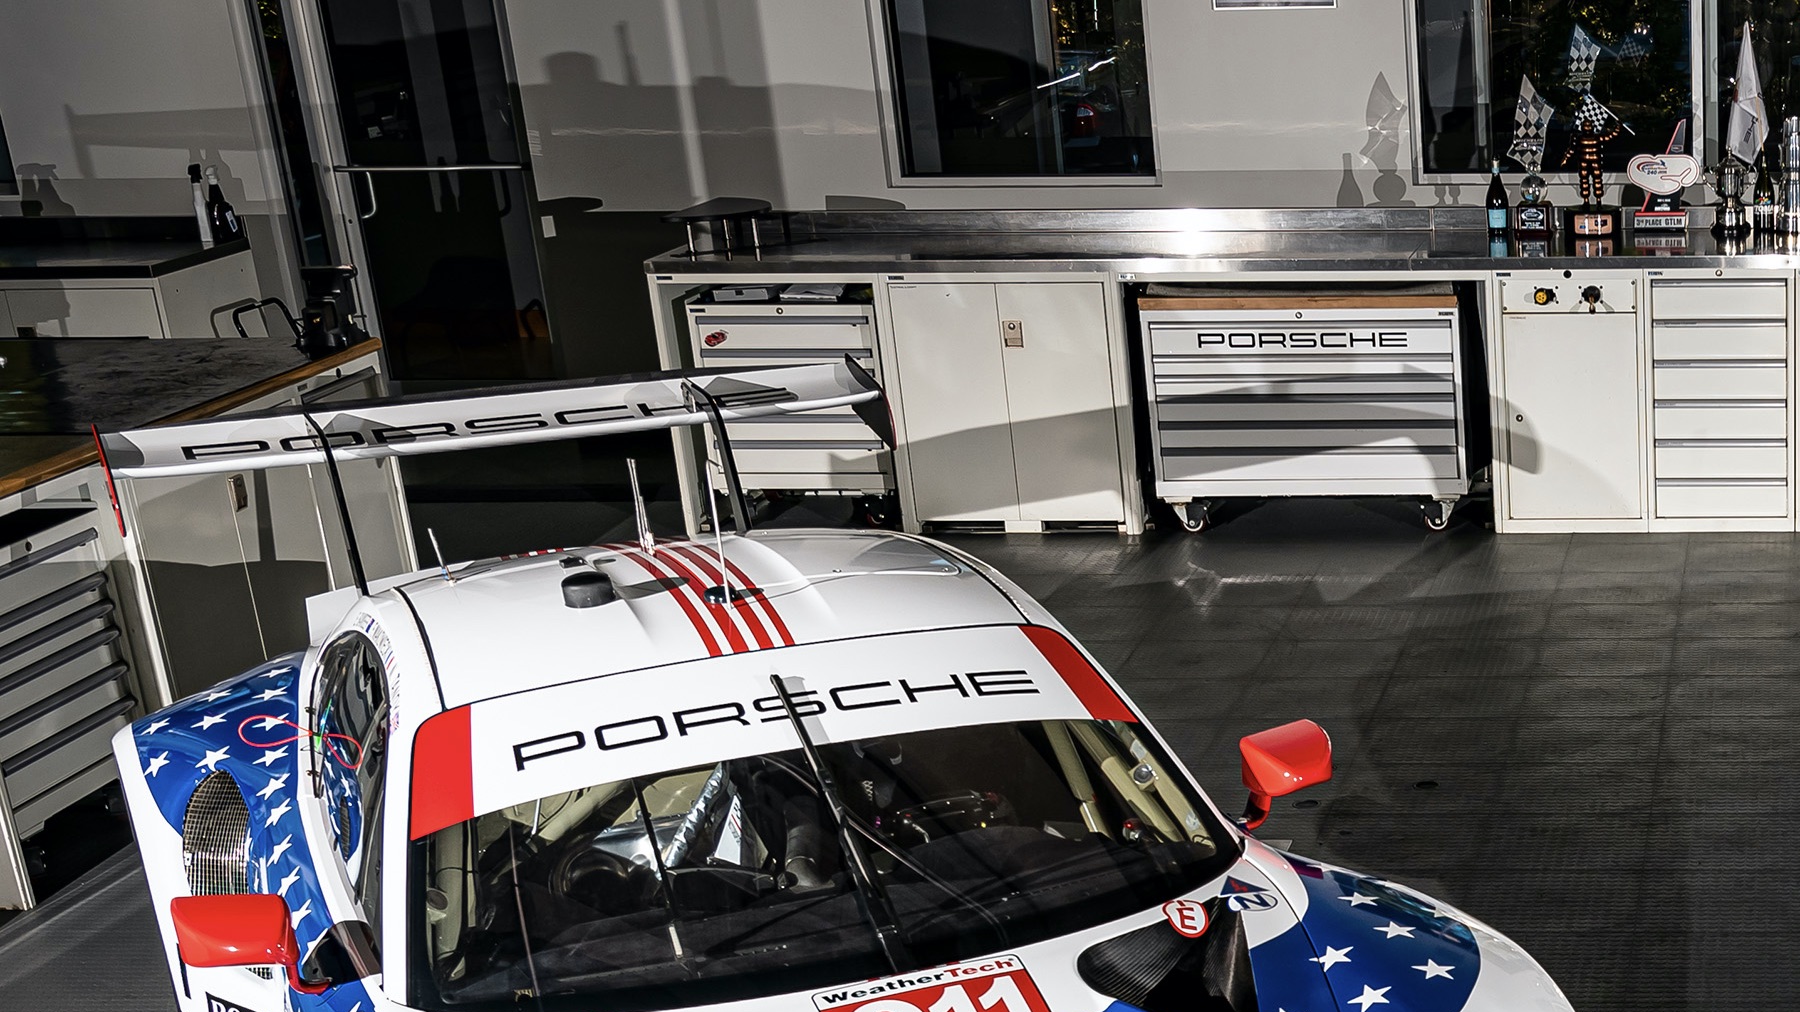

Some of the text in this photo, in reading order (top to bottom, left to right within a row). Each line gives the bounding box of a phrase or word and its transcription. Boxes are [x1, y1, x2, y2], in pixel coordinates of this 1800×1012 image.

[1645, 218, 1662, 226] PLACE
[1664, 217, 1682, 226] GTLM
[1197, 332, 1408, 348] PORSCHE
[181, 387, 799, 461] PORSCHE
[512, 669, 1040, 771] PORSCHE
[821, 958, 1013, 1004] WeatherTech
